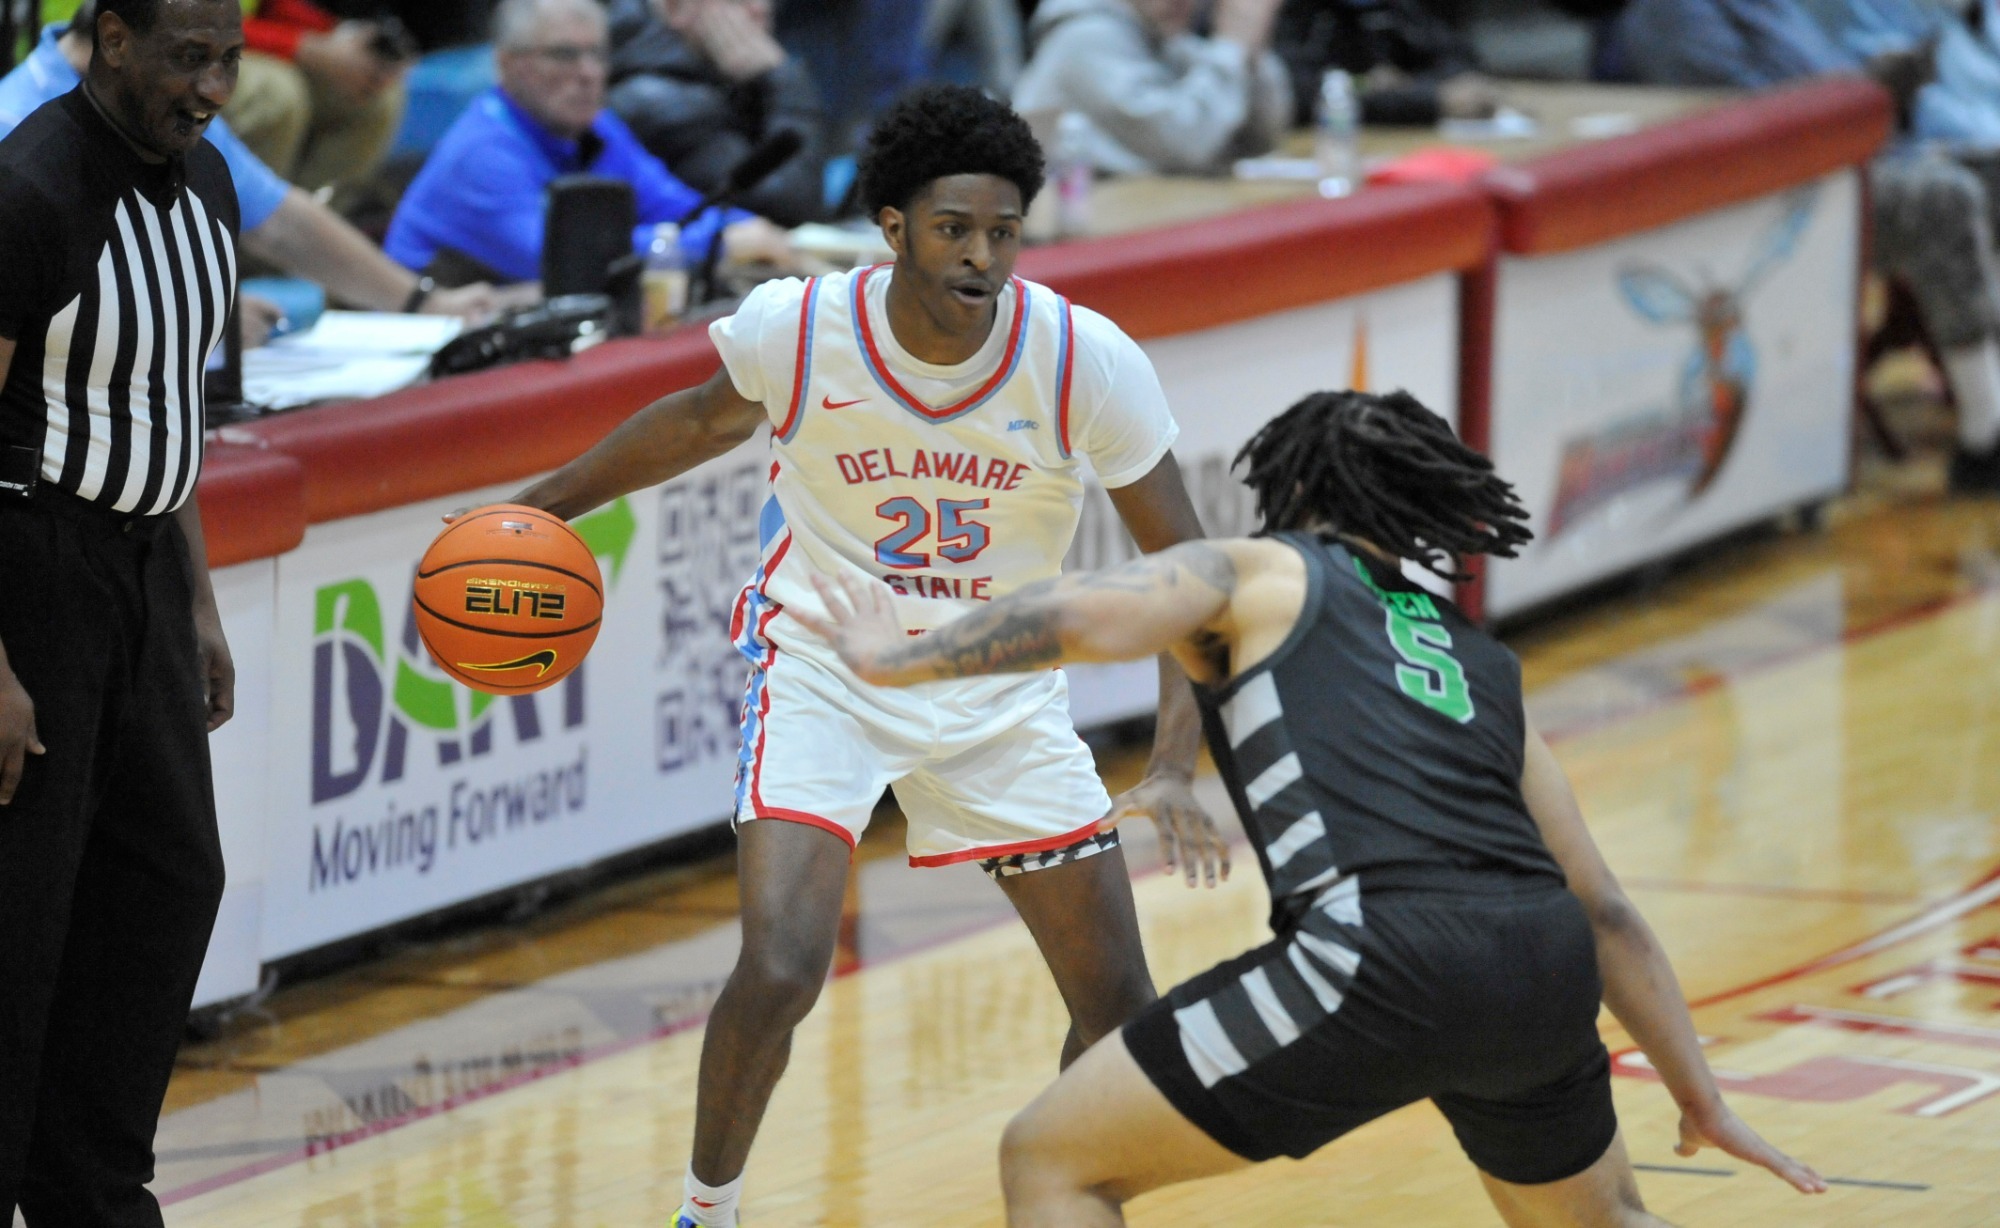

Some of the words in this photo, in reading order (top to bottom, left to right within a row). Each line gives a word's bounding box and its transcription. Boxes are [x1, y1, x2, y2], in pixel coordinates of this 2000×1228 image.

[834, 448, 1032, 491] DELAWARE
[874, 496, 991, 570] 25
[465, 586, 566, 620] ELITE
[883, 574, 993, 601] STATE
[1384, 606, 1476, 724] 5
[309, 800, 438, 894] Moving
[449, 742, 587, 850] Forward
